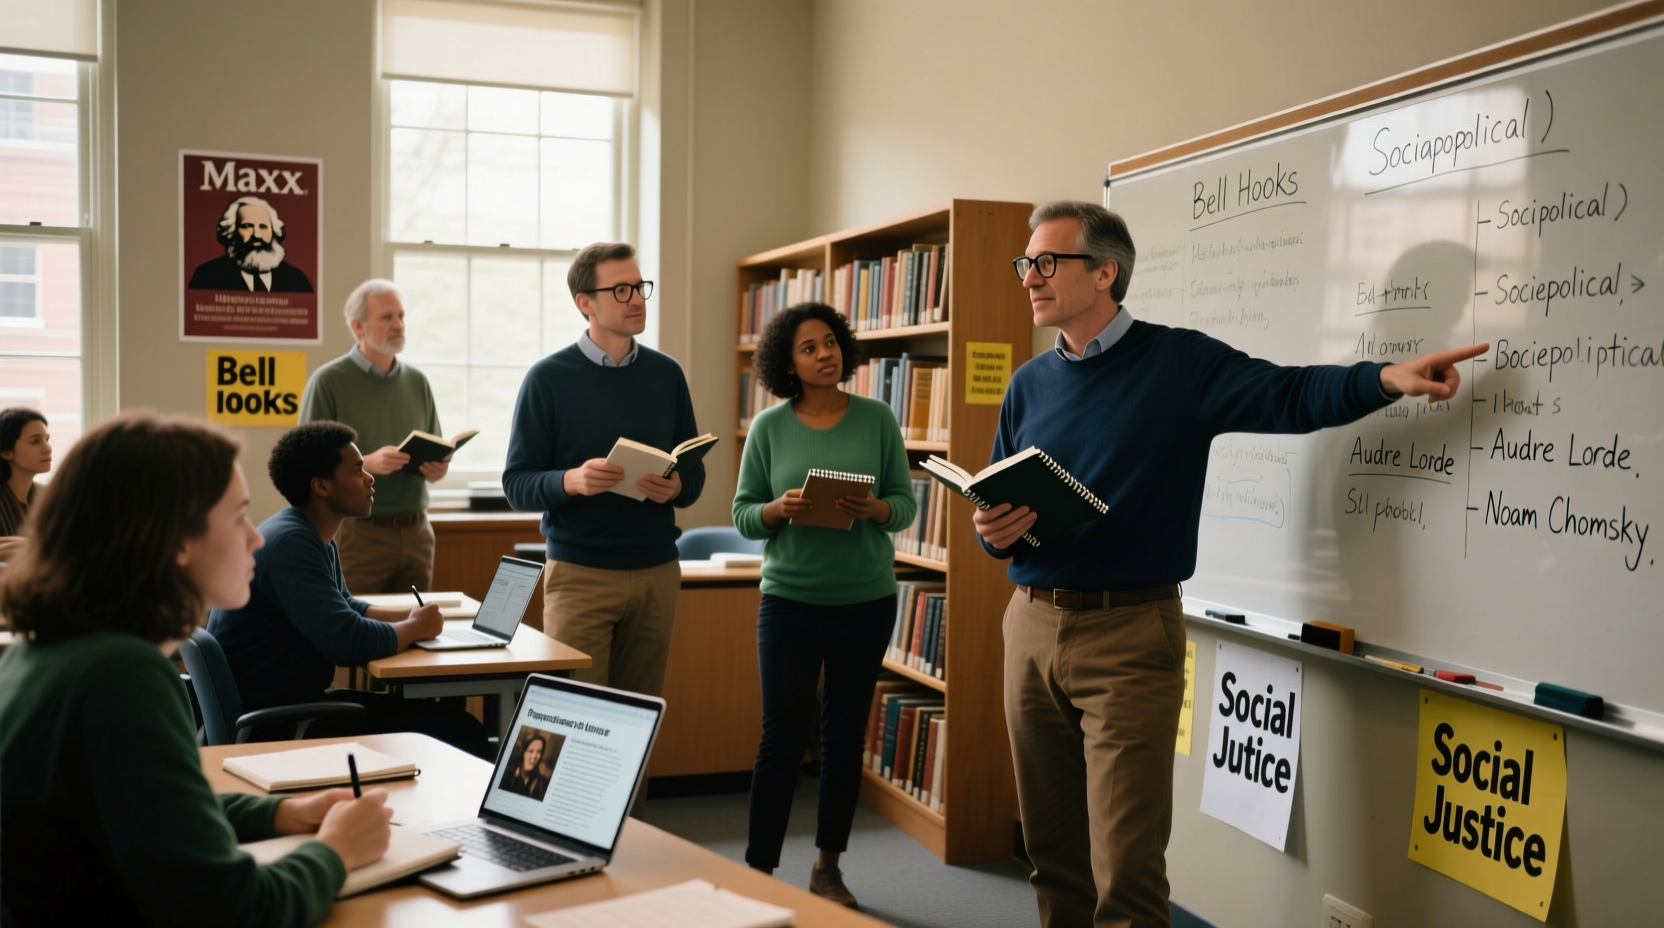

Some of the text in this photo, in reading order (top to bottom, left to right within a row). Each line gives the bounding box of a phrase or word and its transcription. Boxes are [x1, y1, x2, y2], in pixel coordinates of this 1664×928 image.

[1193, 162, 1298, 219] Bell Hooks
[217, 356, 275, 387] Bell
[1350, 436, 1454, 475] Audre Lorde
[1490, 427, 1554, 462] Audre
[1485, 490, 1537, 529] Noam
[1219, 671, 1296, 739] Social
[1212, 725, 1291, 794] Jutice
[1431, 722, 1534, 806] Social
[1423, 784, 1546, 877] Justice
